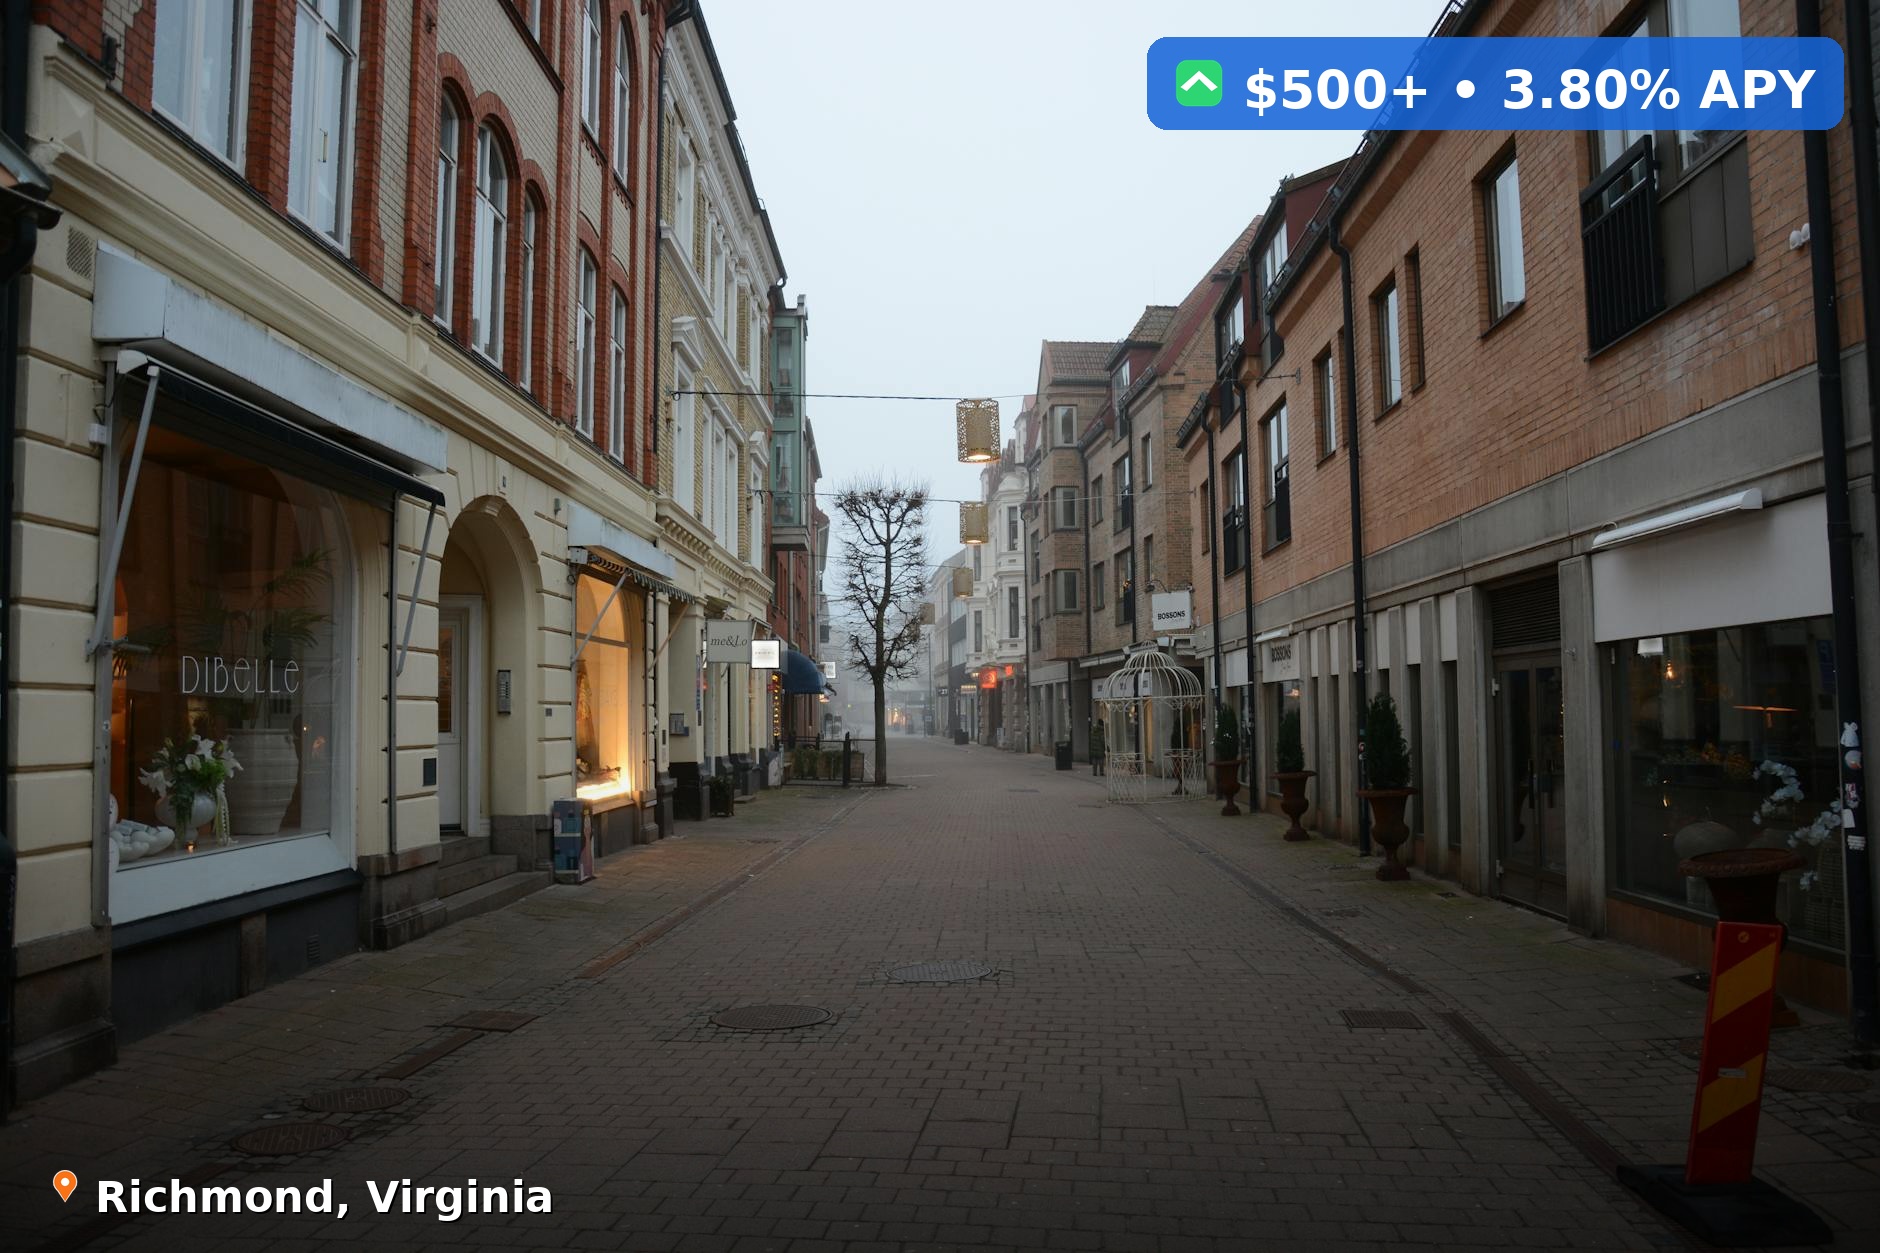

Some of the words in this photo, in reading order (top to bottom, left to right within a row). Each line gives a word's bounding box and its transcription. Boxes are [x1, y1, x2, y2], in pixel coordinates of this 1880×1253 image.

[1157, 610, 1186, 620] BOSSONS
[710, 635, 748, 648] me&Lo
[1271, 644, 1292, 663] BOSSONS
